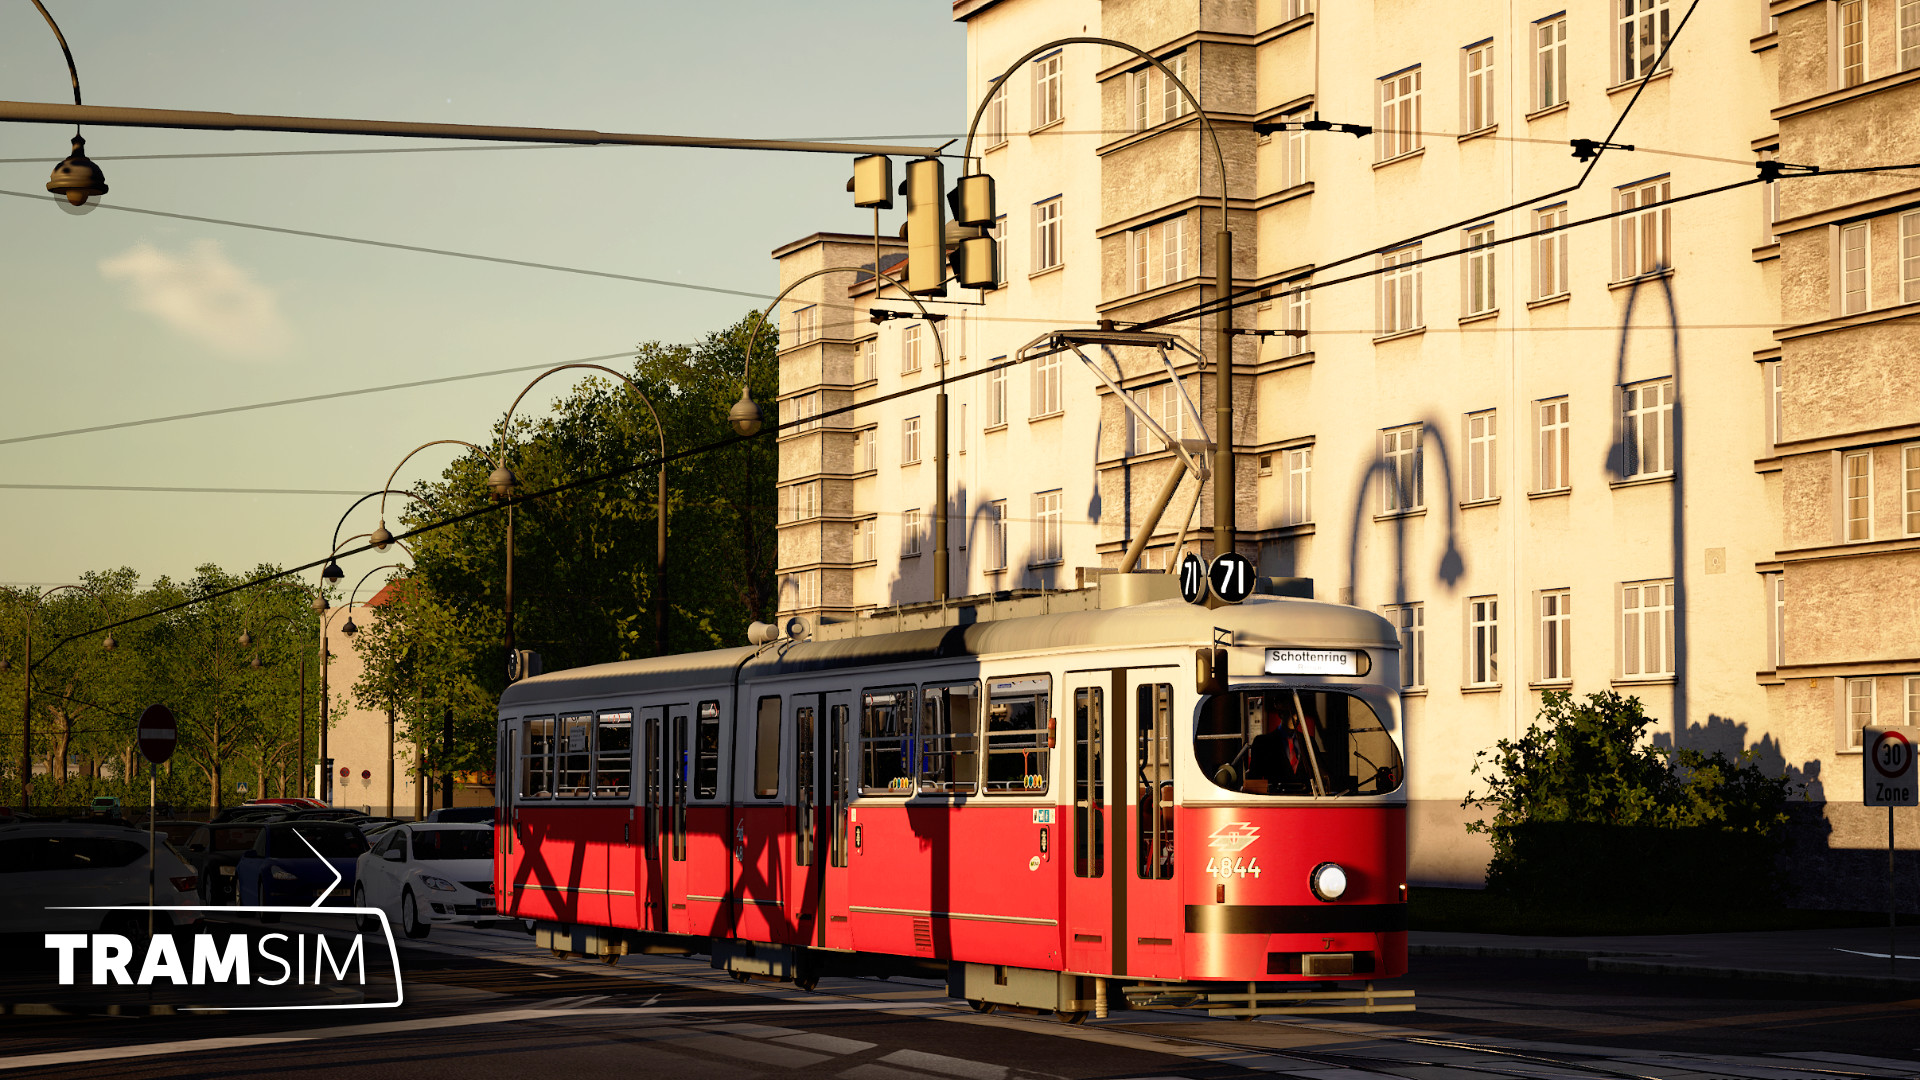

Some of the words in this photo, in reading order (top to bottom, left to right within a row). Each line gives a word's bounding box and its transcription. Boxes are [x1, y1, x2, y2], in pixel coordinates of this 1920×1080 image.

[1184, 561, 1197, 595] 71
[1219, 560, 1244, 594] 71
[1272, 650, 1347, 665] Schottenring
[1882, 743, 1901, 766] 30
[1876, 783, 1910, 802] Zone
[1205, 857, 1262, 878] 4844
